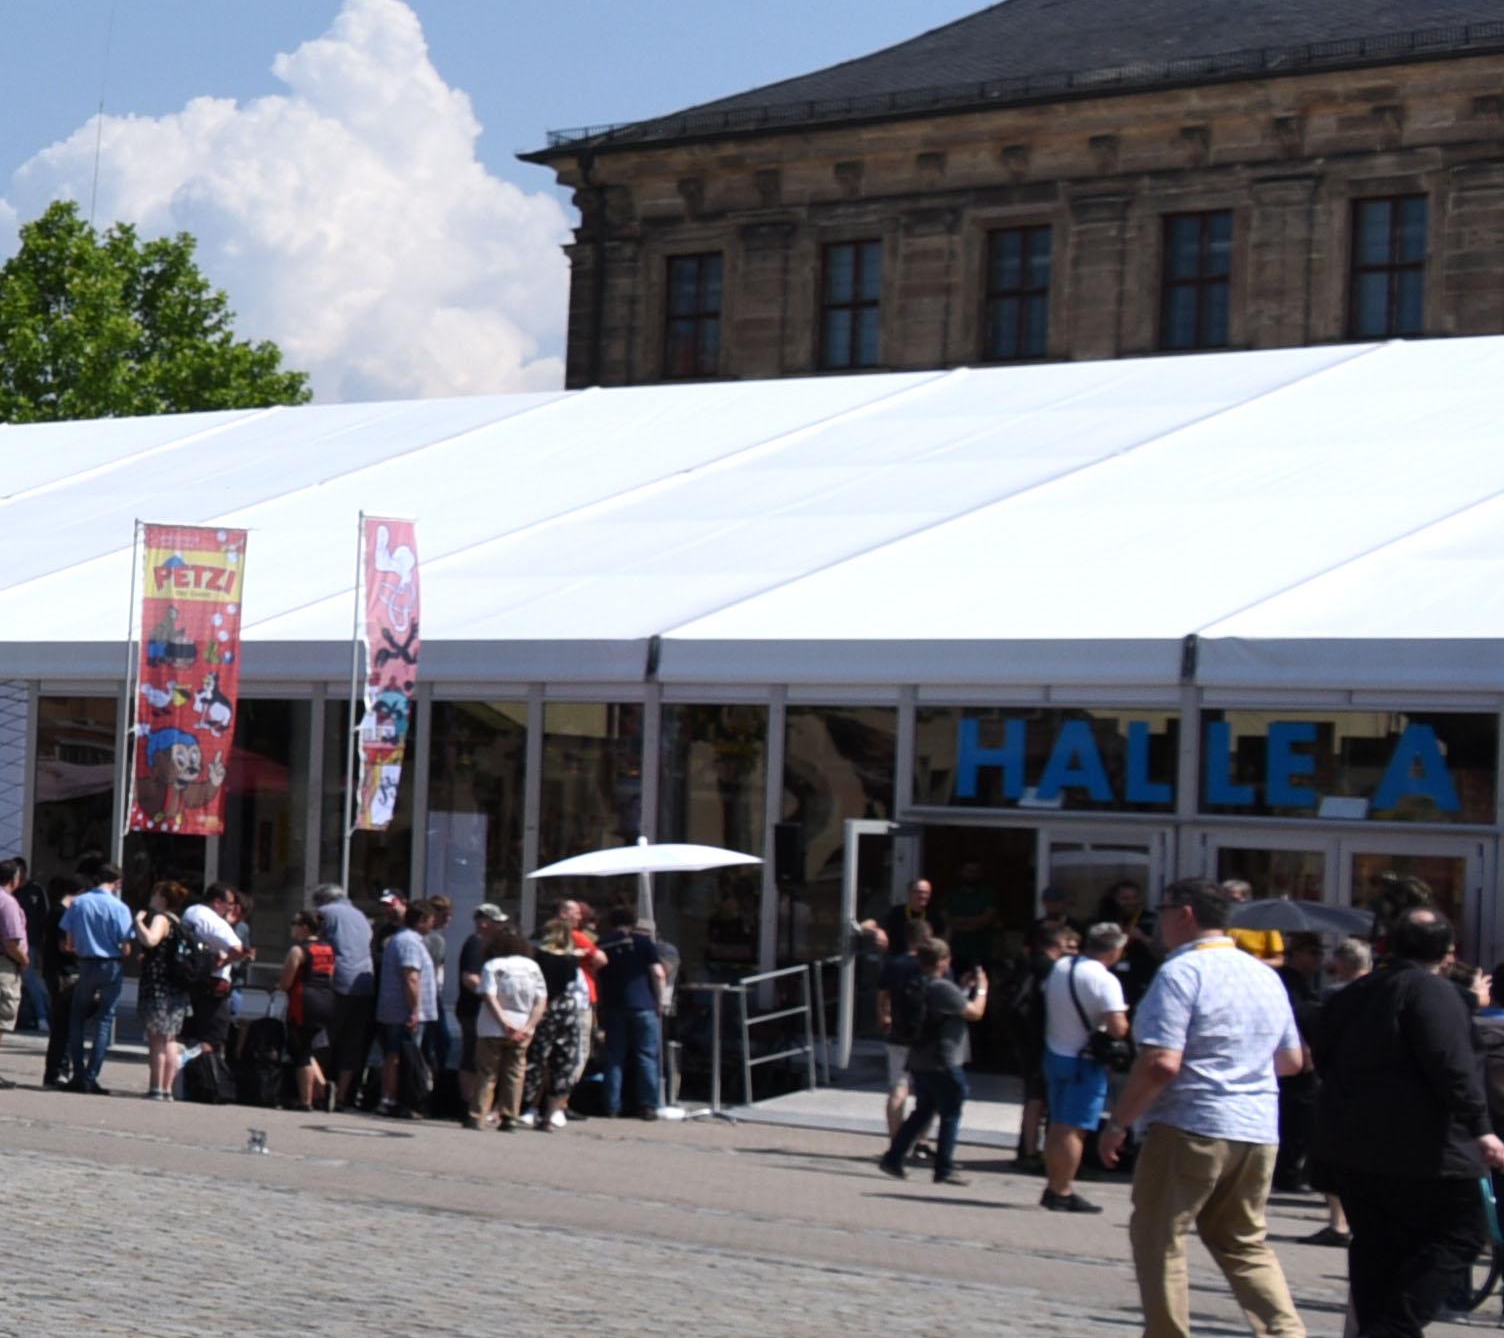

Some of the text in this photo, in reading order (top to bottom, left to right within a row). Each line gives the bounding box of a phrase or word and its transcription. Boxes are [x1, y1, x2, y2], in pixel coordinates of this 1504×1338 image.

[153, 564, 237, 596] PETZI
[955, 717, 1462, 811] HALLE A
